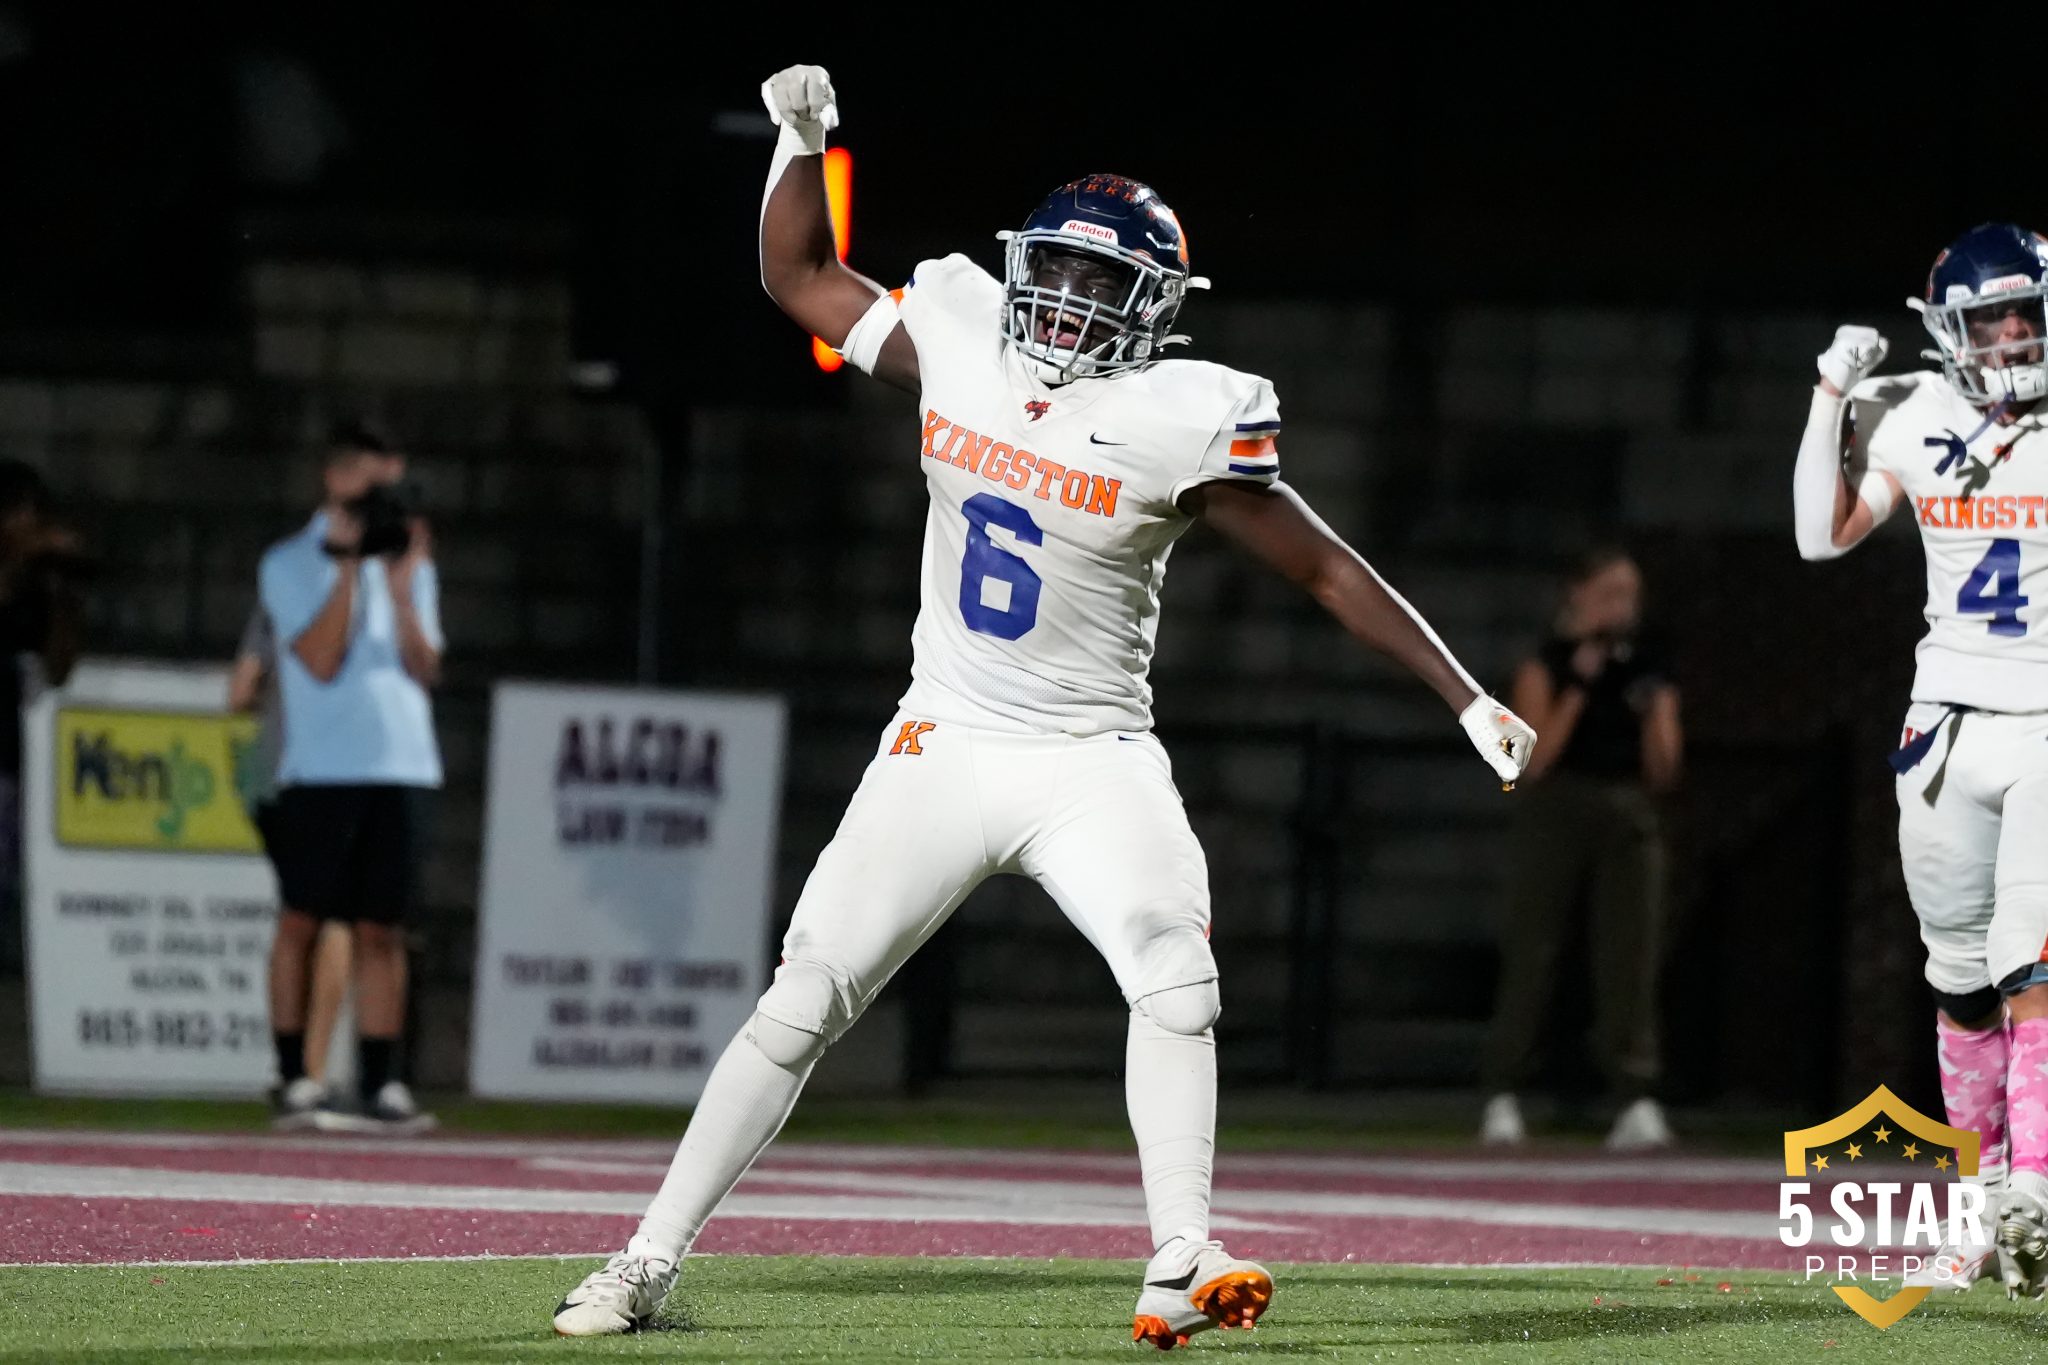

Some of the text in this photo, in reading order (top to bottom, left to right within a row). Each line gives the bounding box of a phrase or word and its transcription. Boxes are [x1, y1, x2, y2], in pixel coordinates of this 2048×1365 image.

[1067, 222, 1113, 240] Riddell
[922, 409, 1123, 518] KINGSTON
[1917, 495, 2048, 529] KINGST
[959, 492, 1043, 641] 6
[1956, 538, 2029, 637] 4
[889, 721, 936, 755] K
